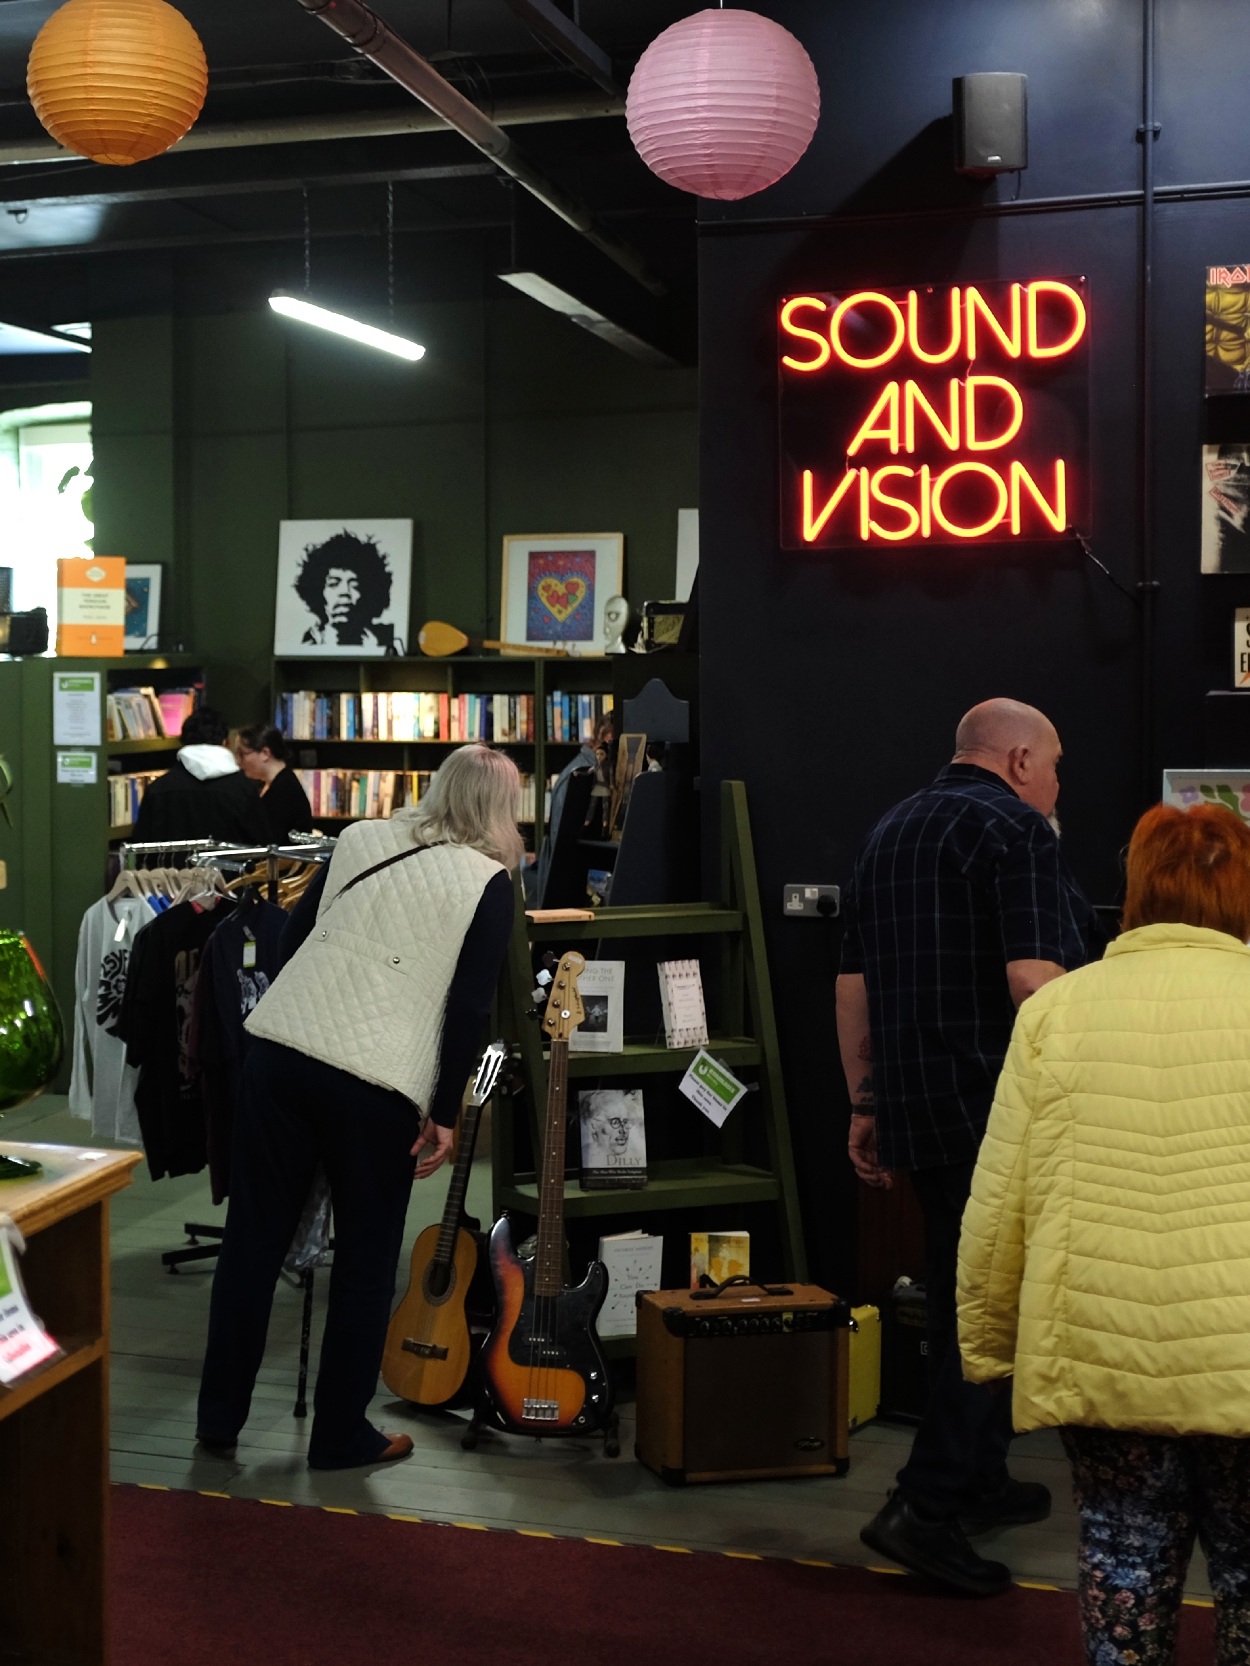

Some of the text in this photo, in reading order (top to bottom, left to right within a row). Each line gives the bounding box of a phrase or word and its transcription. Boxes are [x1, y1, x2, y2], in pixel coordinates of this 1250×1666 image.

[781, 281, 1086, 371] SOUND
[846, 375, 1023, 456] AND
[803, 459, 1066, 542] VISION
